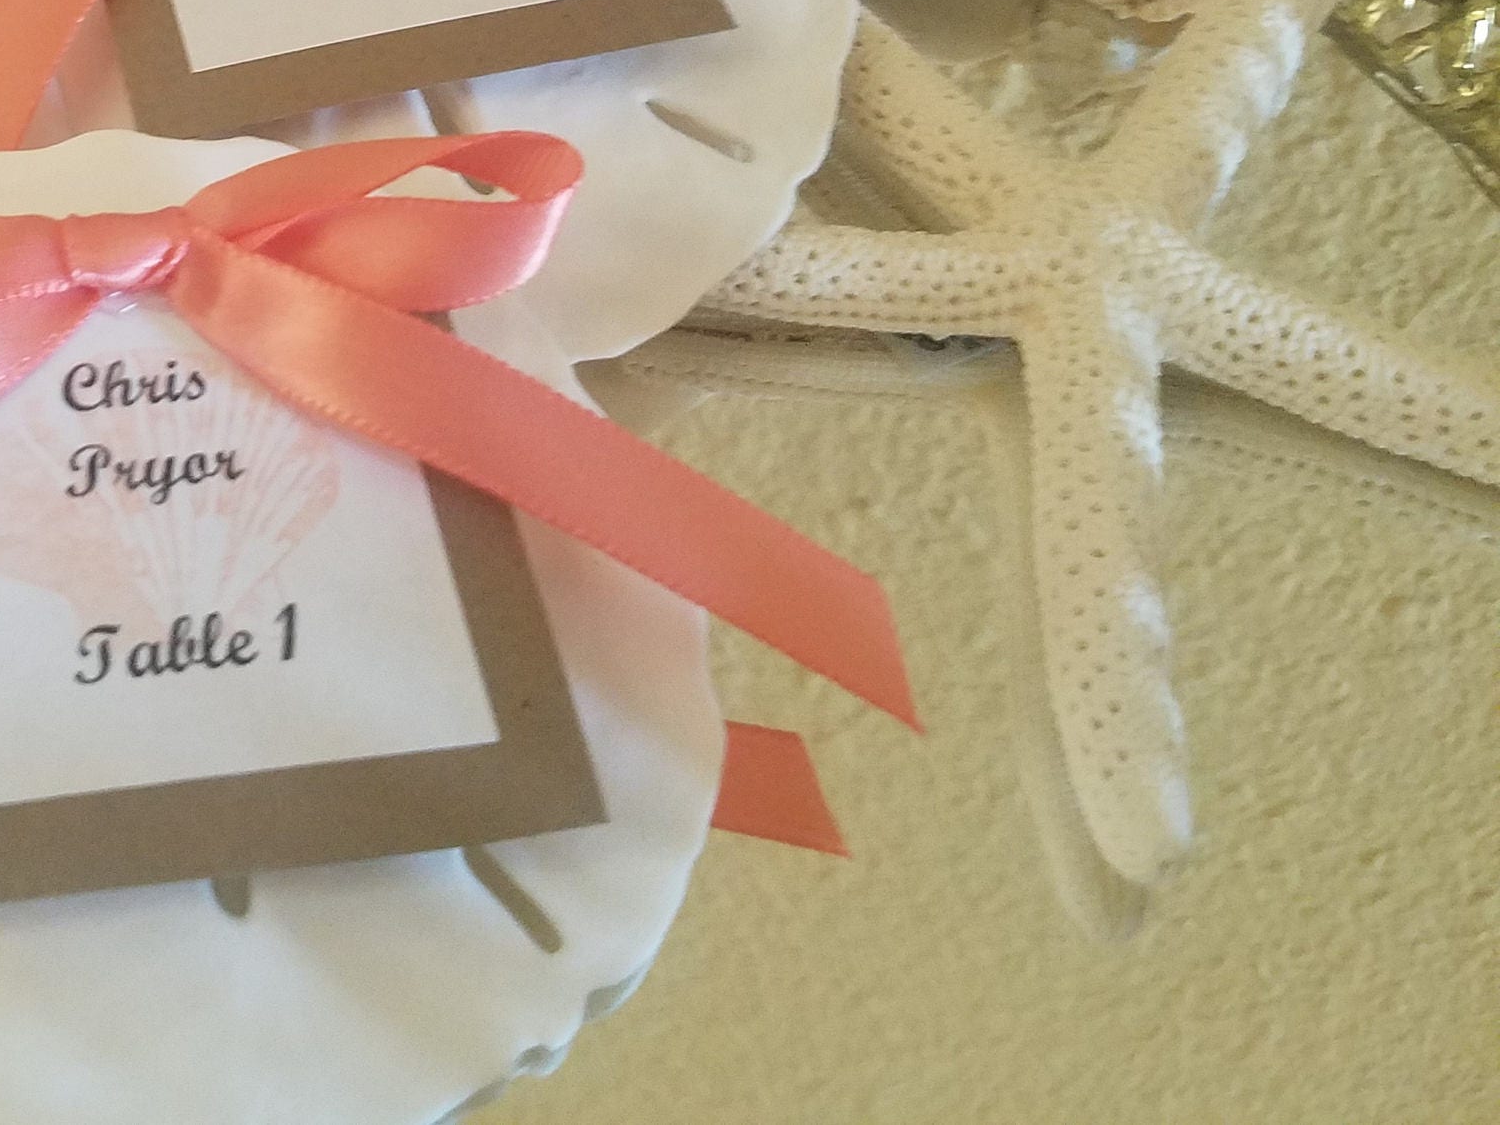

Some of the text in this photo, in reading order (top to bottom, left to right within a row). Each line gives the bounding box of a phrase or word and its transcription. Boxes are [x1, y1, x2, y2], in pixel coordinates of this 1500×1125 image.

[64, 361, 205, 411] Chris
[66, 444, 245, 504] Pryor
[75, 603, 297, 684] Table 1
